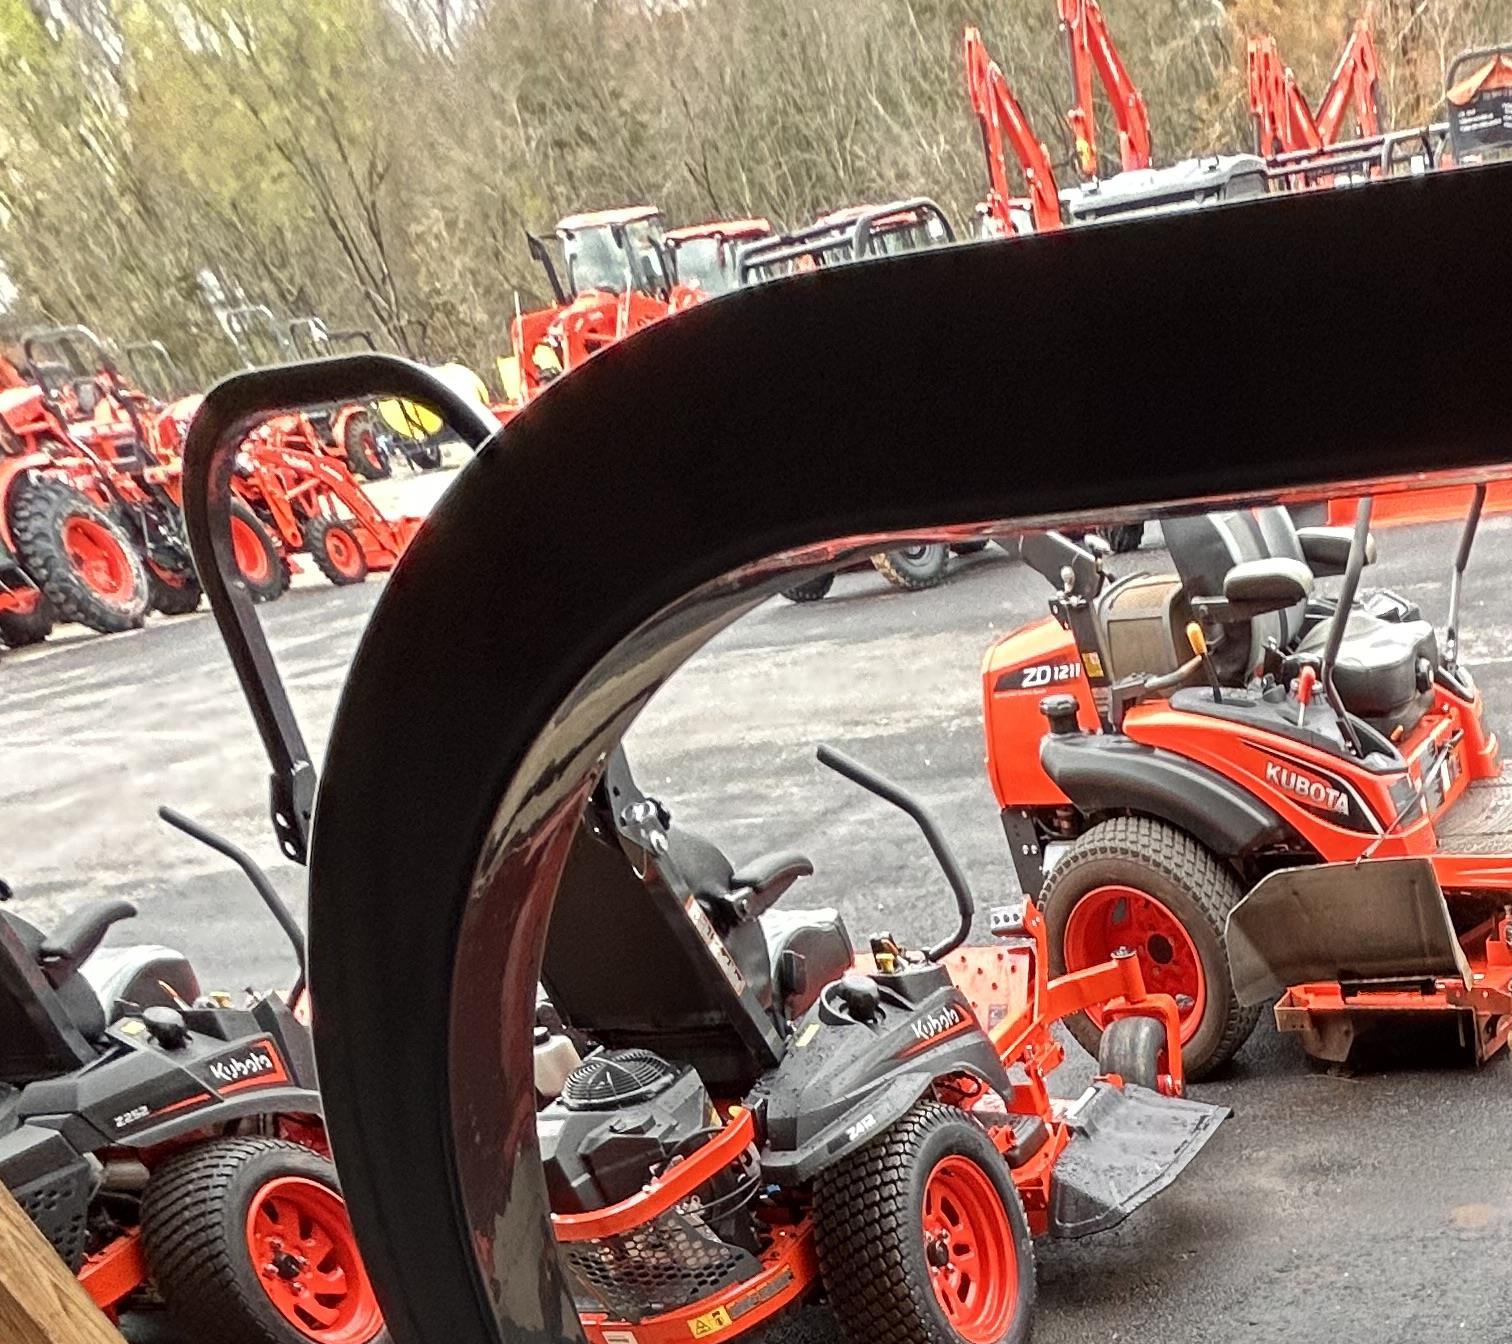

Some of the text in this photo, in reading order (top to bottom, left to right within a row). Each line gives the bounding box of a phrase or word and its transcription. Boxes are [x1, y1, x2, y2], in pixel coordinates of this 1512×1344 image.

[1265, 761, 1350, 816] KUBOTA
[912, 1006, 960, 1040] Kubota
[209, 1052, 273, 1081] Kubota
